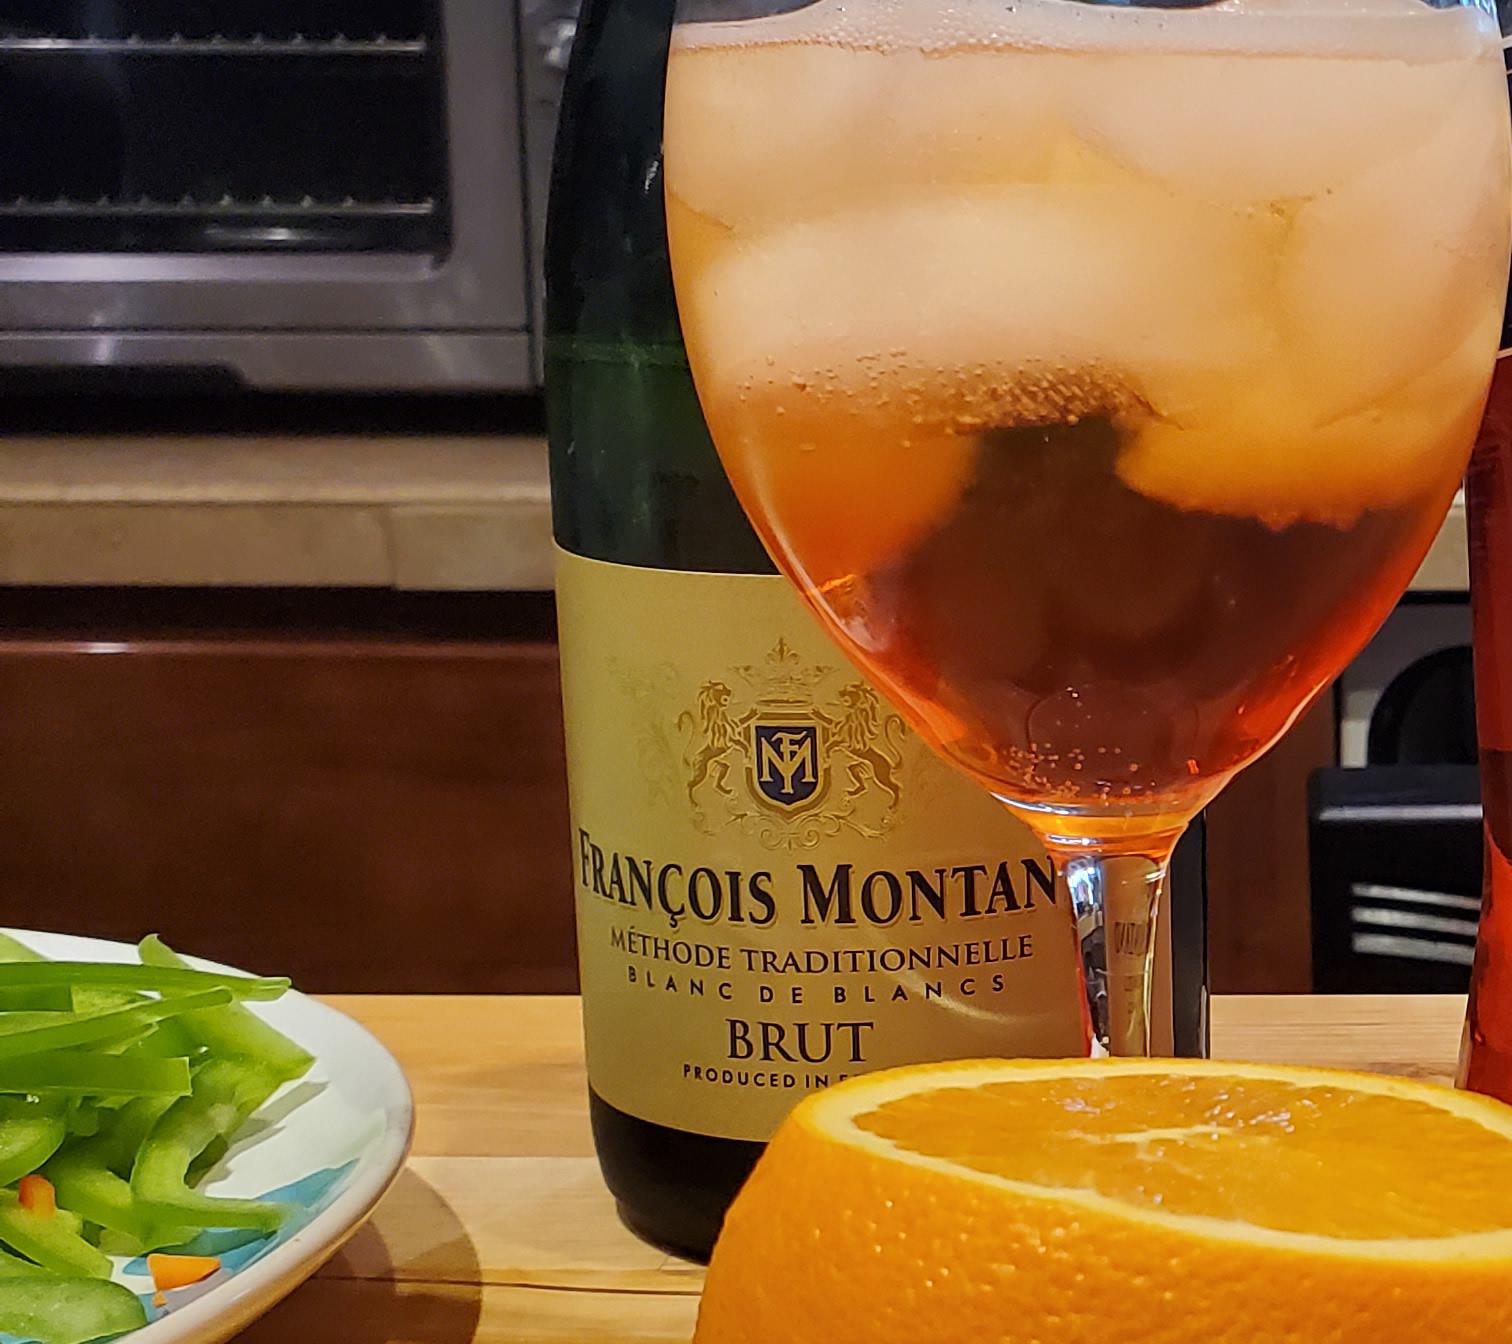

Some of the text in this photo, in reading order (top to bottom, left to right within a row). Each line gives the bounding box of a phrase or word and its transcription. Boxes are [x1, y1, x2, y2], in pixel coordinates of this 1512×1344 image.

[578, 827, 1057, 929] FRANÇOIS MONTAN
[610, 925, 1033, 974] MÉTHODE TRADITIONNELLE
[628, 965, 1005, 1004] BLANC DE BLANCS
[725, 1018, 874, 1063] BRUT
[683, 1063, 796, 1088] PRODUCED
[805, 1074, 829, 1089] IN
